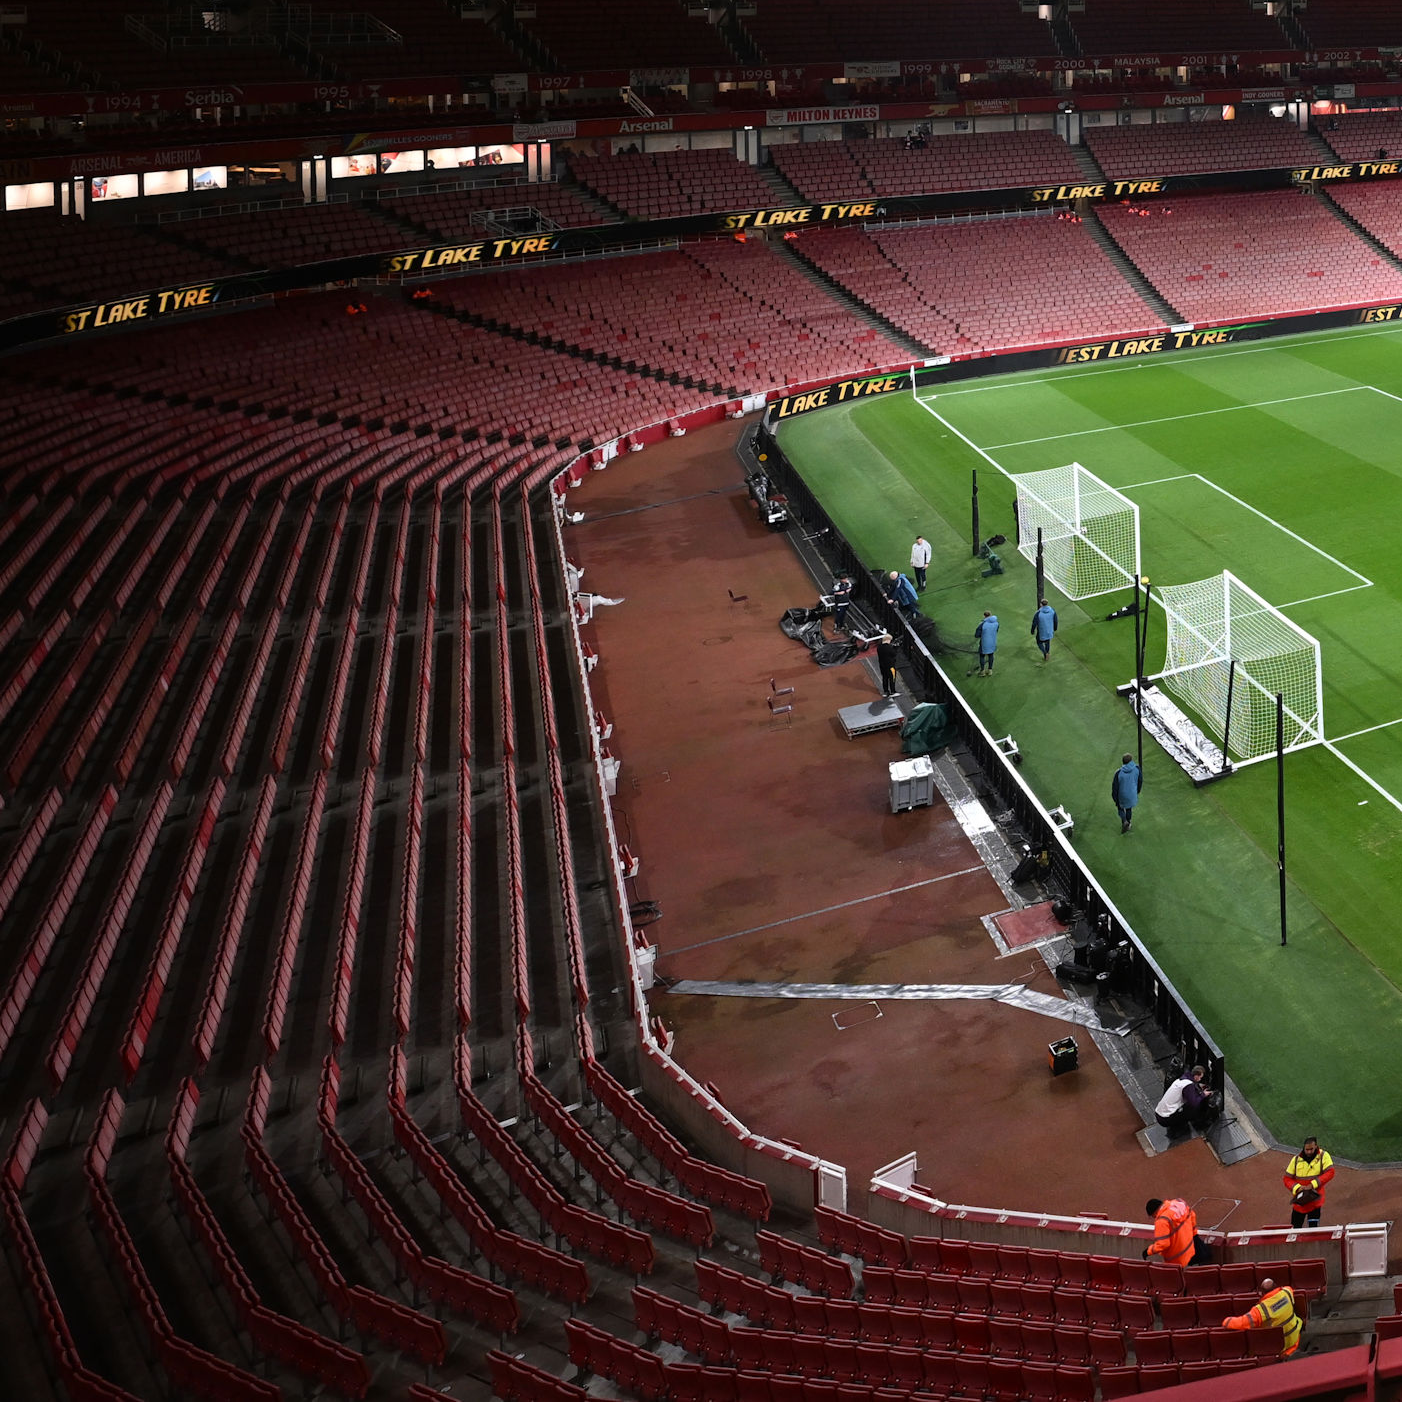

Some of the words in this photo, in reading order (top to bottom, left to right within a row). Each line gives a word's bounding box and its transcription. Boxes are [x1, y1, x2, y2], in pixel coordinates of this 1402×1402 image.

[1114, 57, 1160, 66] MALAYSIA
[1182, 56, 1208, 65] 2001
[1324, 51, 1350, 61] 2002
[904, 64, 932, 74] 1999
[1054, 59, 1085, 69] 2000
[538, 76, 571, 88] 1997
[741, 69, 772, 80] 1998
[184, 89, 235, 106] Serbia
[313, 85, 350, 98] 1995
[1164, 93, 1204, 105] Arsenal
[105, 96, 141, 110] 1994
[787, 109, 830, 122] MILTON
[833, 107, 877, 120] KEYNES
[619, 118, 673, 133] Arsenal
[70, 156, 123, 173] ARSENAL
[154, 150, 201, 165] AMERICA
[1311, 166, 1352, 180] LAKE
[1359, 162, 1399, 175] TYRE
[1056, 184, 1106, 200] LAKE
[1113, 180, 1162, 196] TYRE
[753, 209, 811, 226] LAKE
[821, 203, 876, 220] TYRE
[421, 246, 484, 268] LAKE
[493, 236, 552, 258] TYRE
[94, 298, 150, 327] LAKE
[158, 286, 213, 313] TYRE
[1358, 307, 1397, 323] EST
[1058, 346, 1104, 364] EST
[1108, 337, 1166, 358] LAKE
[1174, 331, 1227, 349] TYRE
[779, 390, 829, 417] LAKE
[838, 378, 896, 400] TYRE
